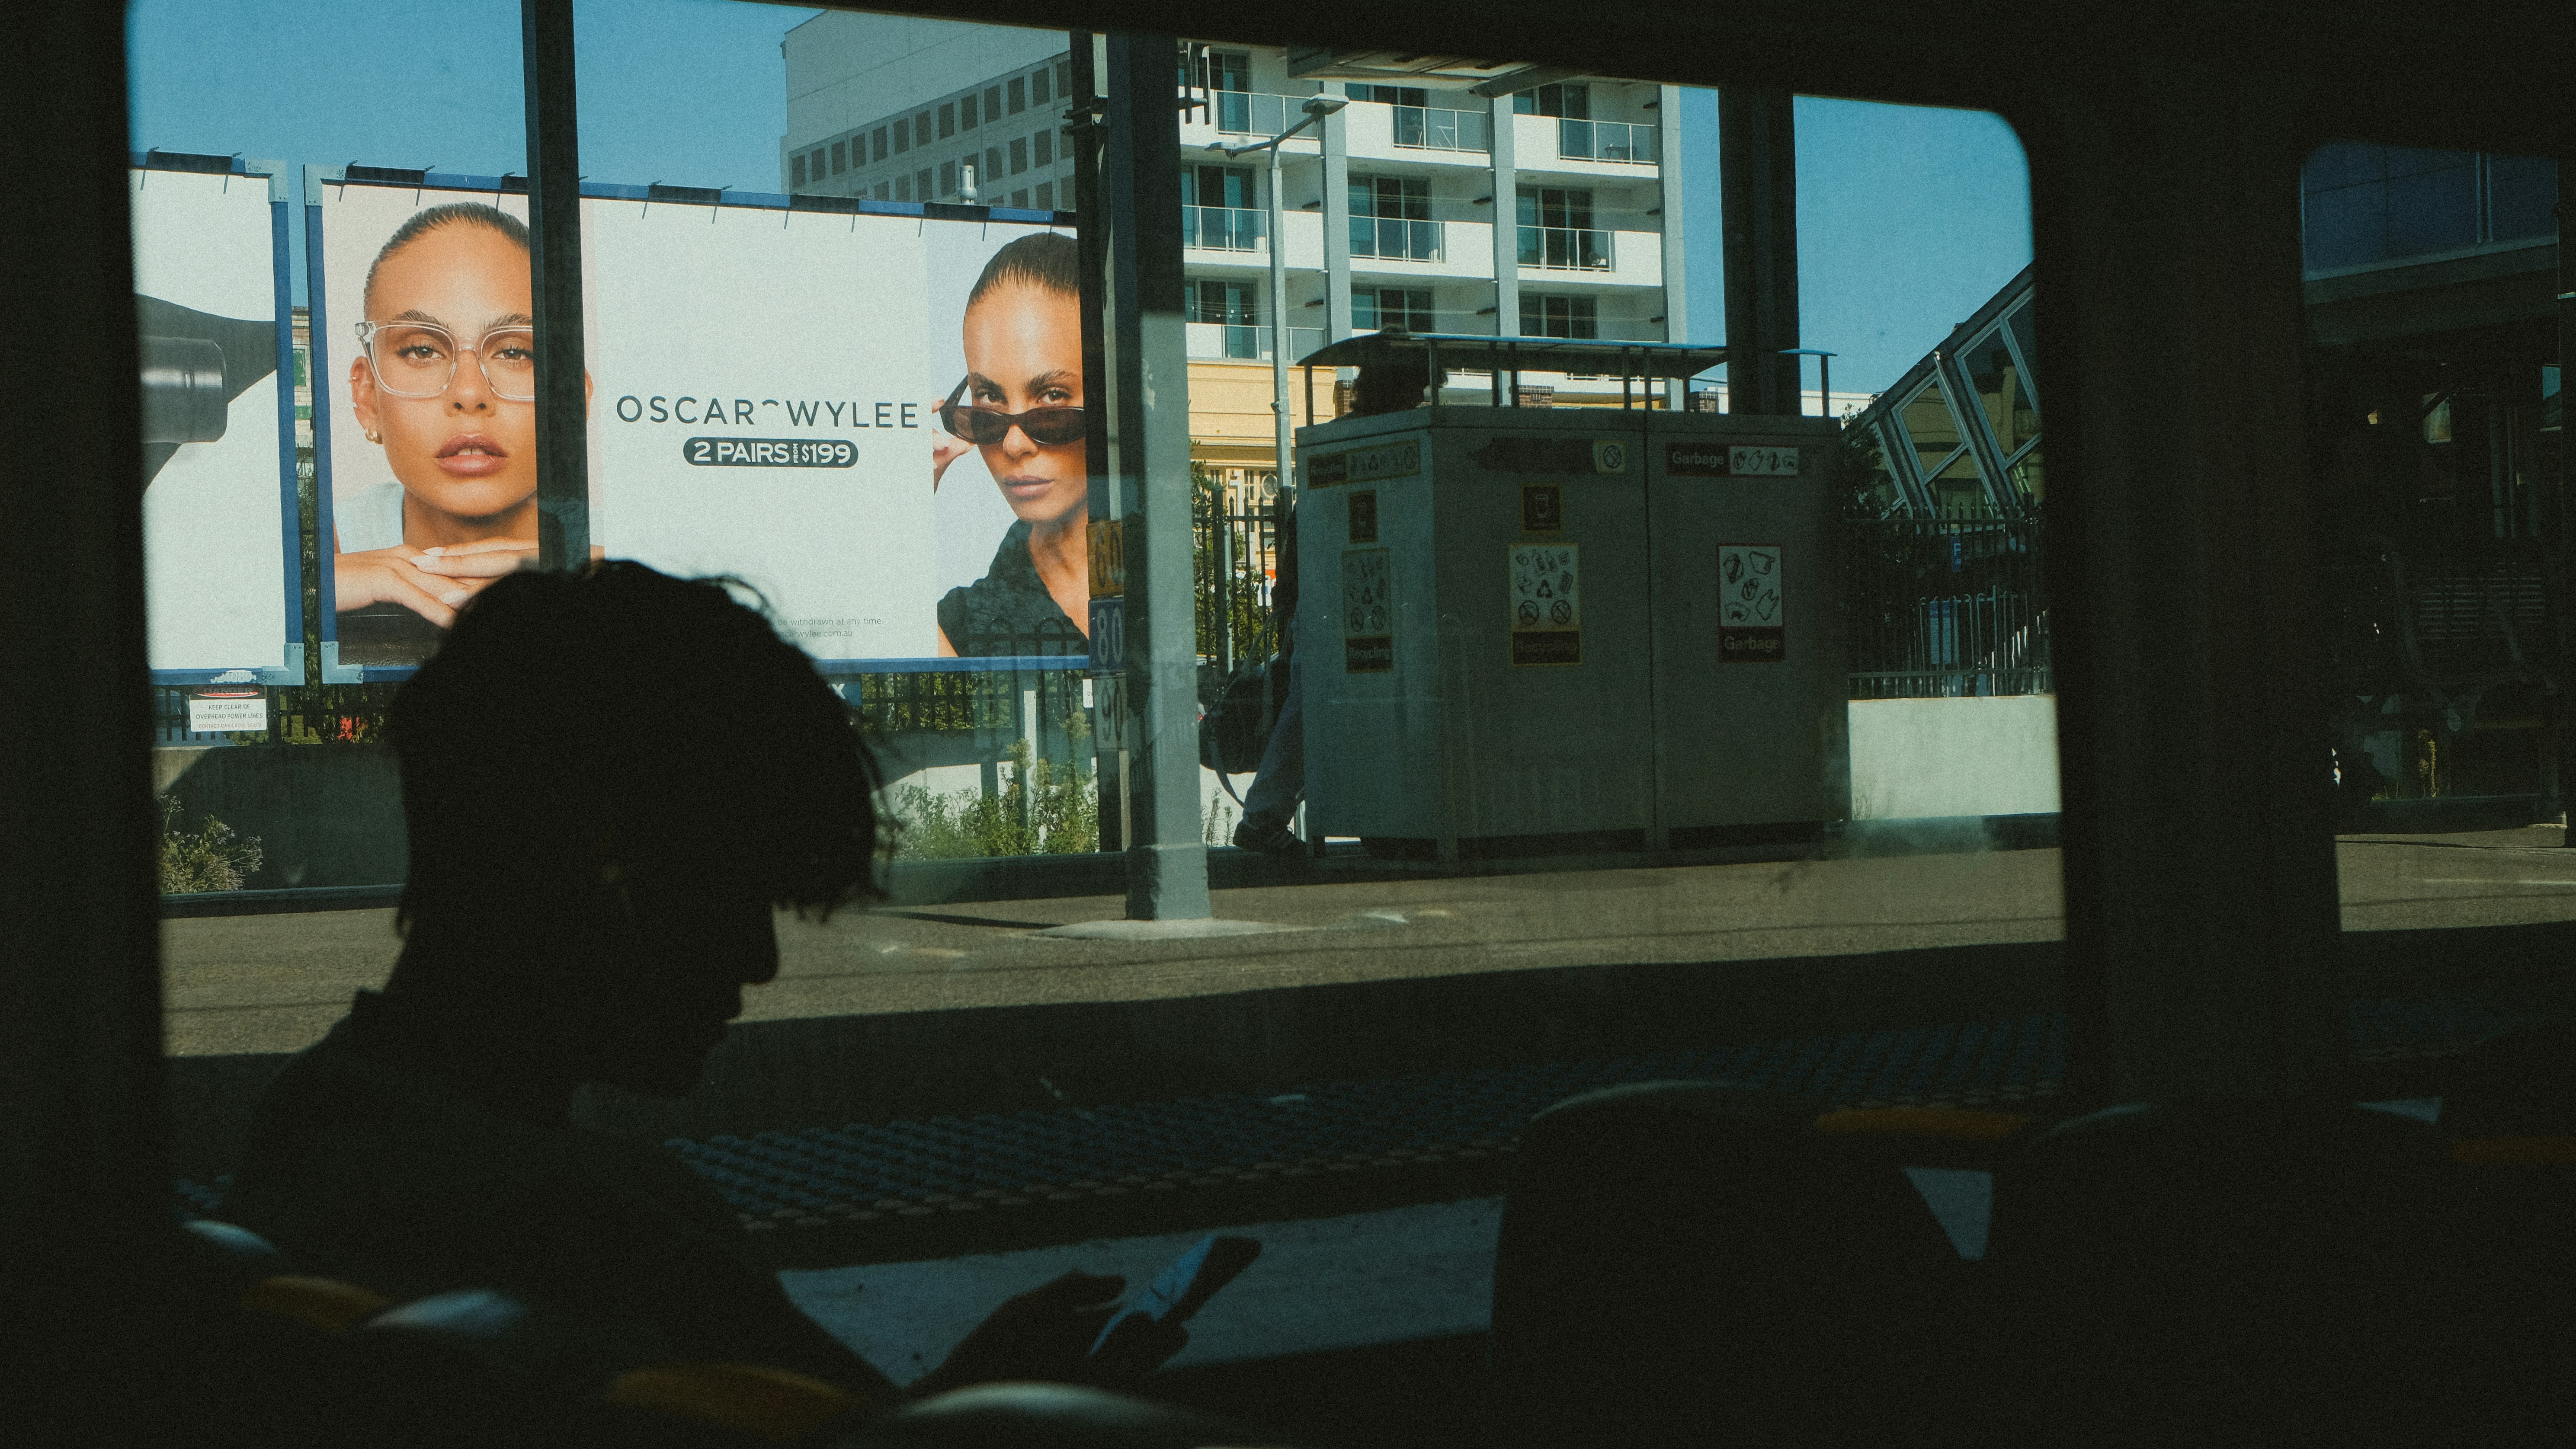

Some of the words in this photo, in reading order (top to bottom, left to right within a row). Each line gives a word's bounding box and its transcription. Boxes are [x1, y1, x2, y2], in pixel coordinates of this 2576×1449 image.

[616, 395, 755, 425] OSCAR
[785, 400, 918, 429] WYLEE
[694, 441, 711, 462] 2
[718, 442, 790, 464] PAIRS
[802, 444, 851, 464] $199
[1672, 451, 1724, 468] Garbage
[1095, 528, 1121, 588] 60
[1097, 606, 1123, 665] 80
[1724, 635, 1780, 653] Garbage
[1348, 645, 1390, 661] Recycling
[1101, 680, 1124, 741] 90
